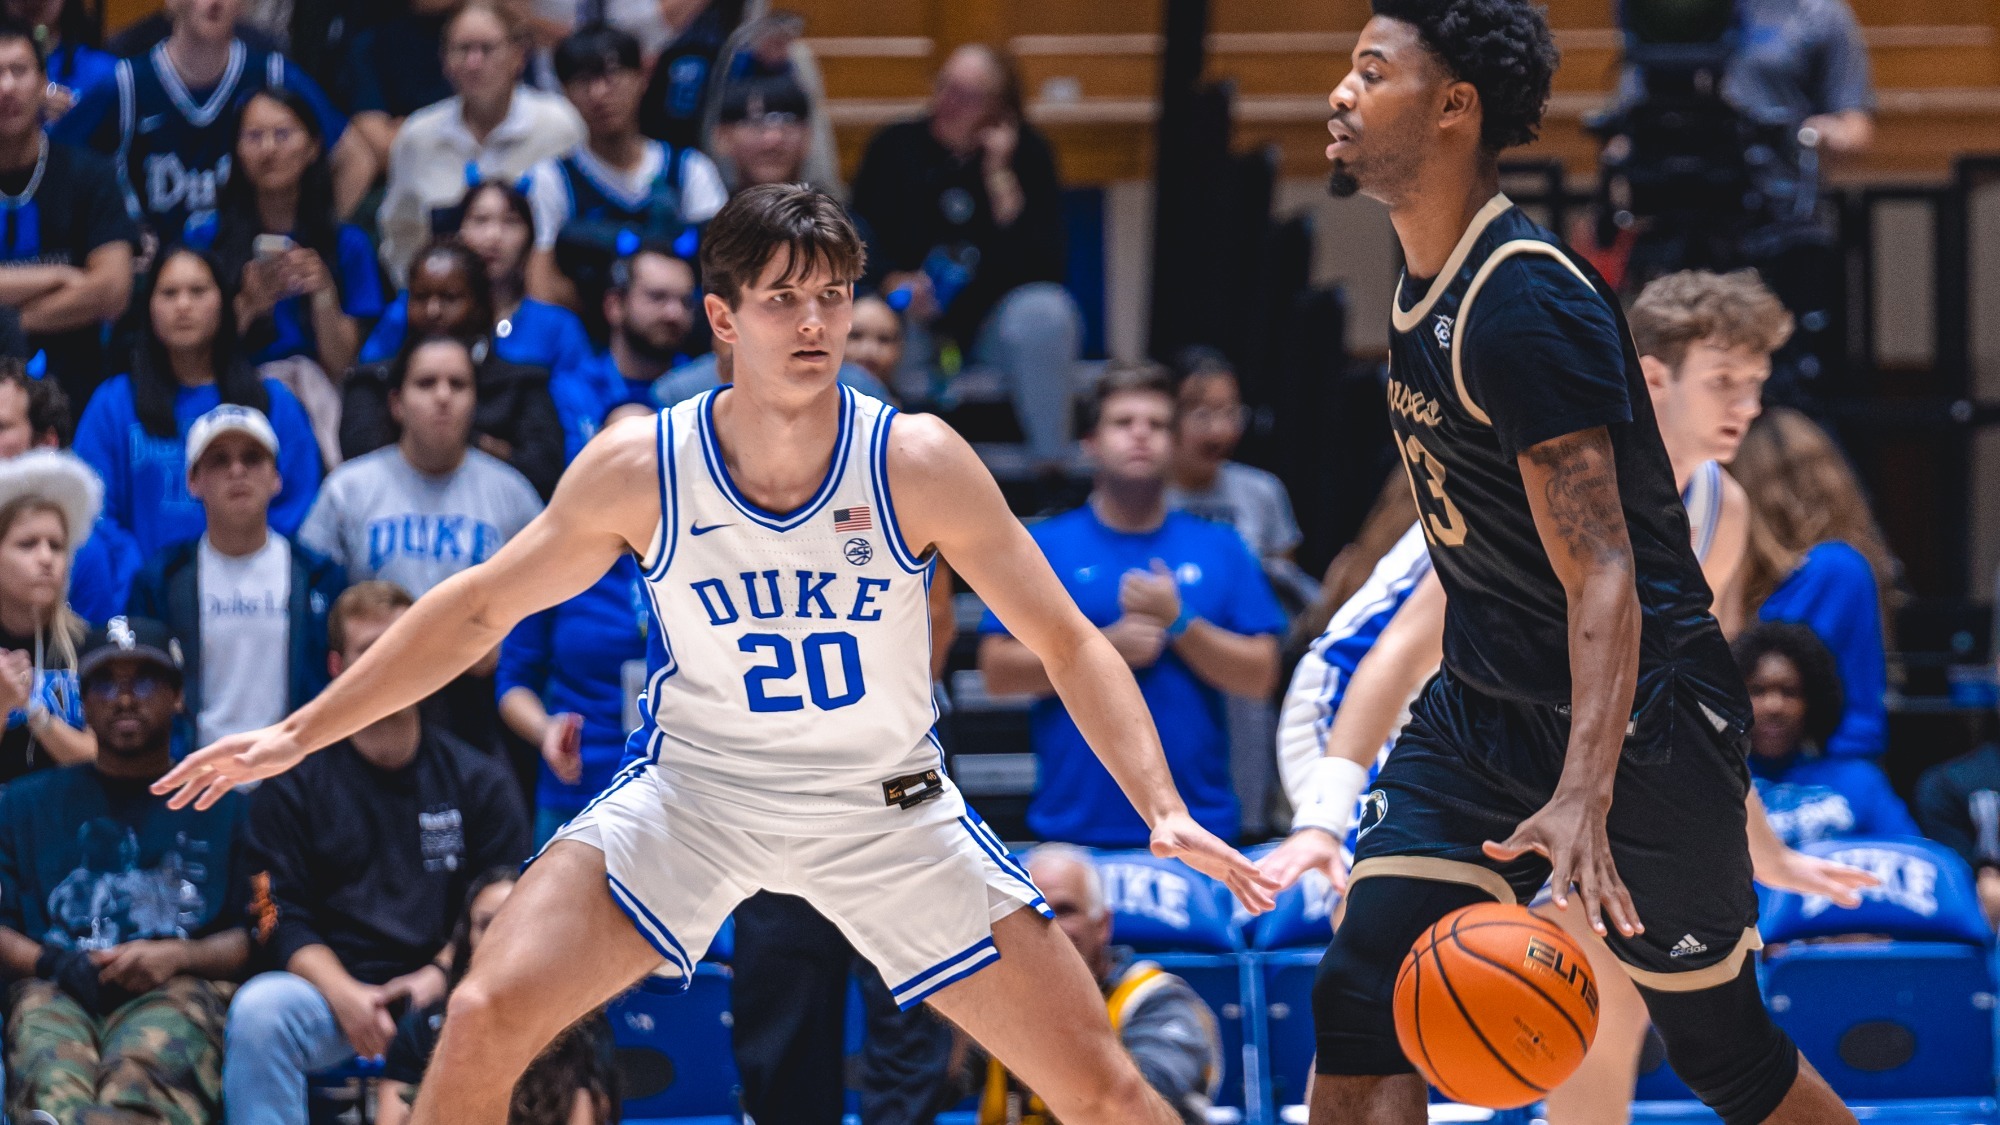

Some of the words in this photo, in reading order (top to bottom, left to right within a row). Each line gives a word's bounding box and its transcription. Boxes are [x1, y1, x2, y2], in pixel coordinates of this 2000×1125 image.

[1393, 429, 1468, 548] 13
[690, 569, 891, 626] DUKE
[737, 631, 866, 713] 20
[1101, 863, 1190, 929] UKE
[1524, 936, 1600, 1018] ELITE
[1670, 944, 1708, 958] adidas
